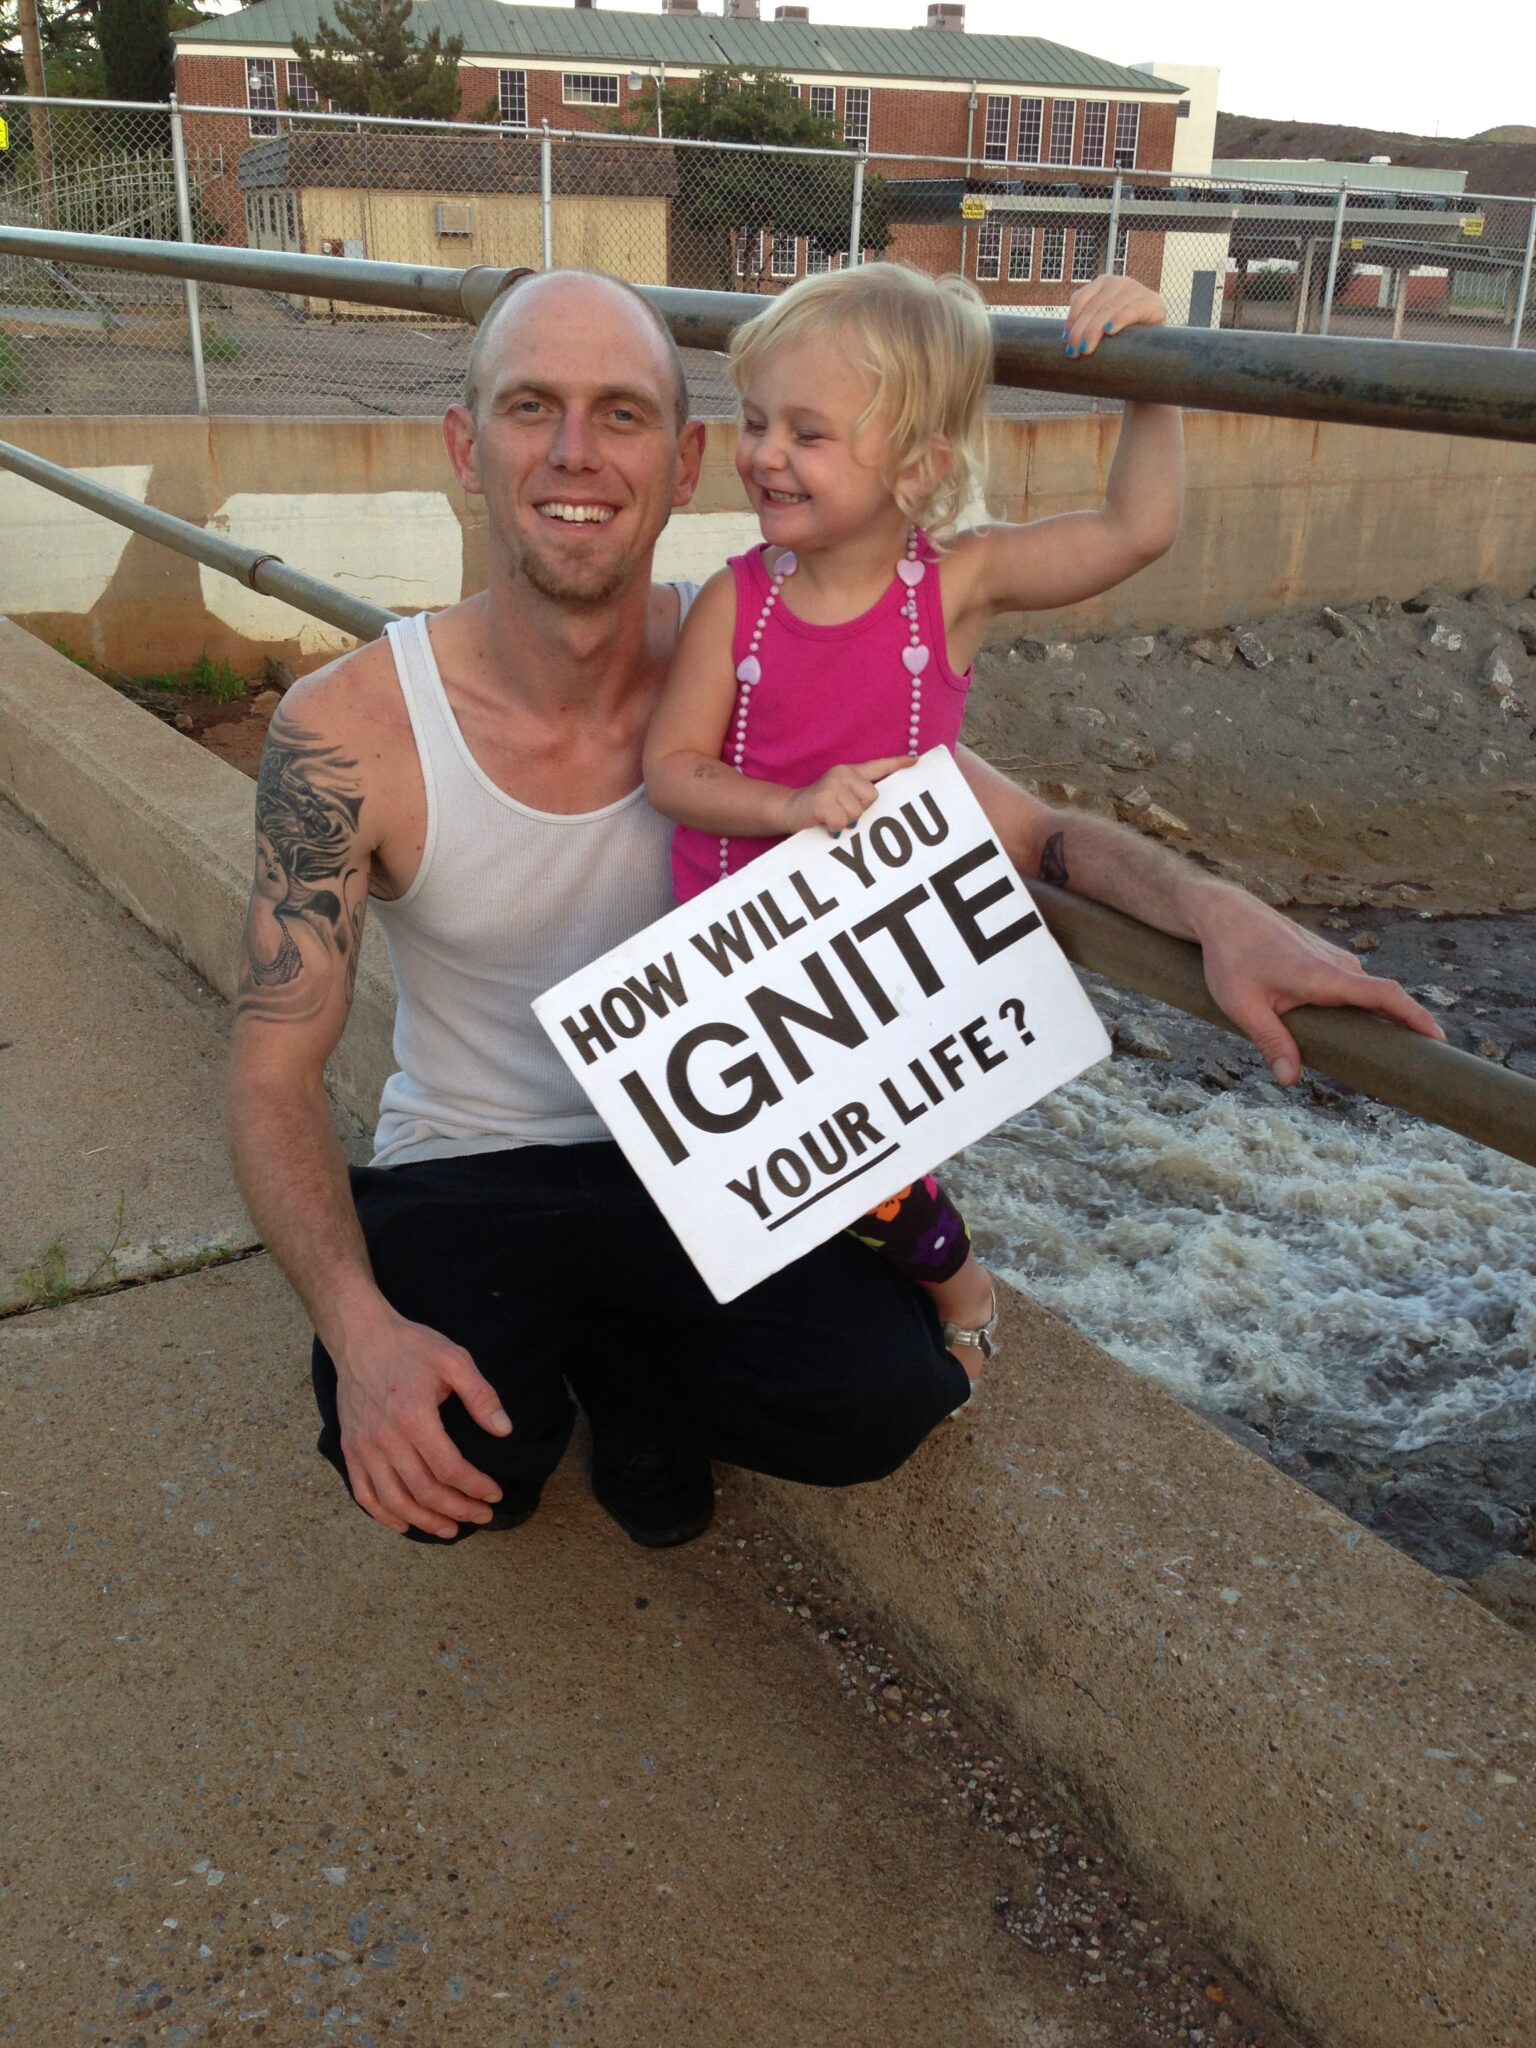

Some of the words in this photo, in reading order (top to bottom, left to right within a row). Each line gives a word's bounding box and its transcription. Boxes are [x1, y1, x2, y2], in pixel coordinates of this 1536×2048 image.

[561, 951, 688, 1065] HOW
[689, 870, 839, 978] WILL
[829, 790, 950, 889] YOU
[620, 839, 1042, 1166] IGNITE
[725, 1101, 885, 1221] YOUR
[879, 997, 1036, 1125] LIFE?
